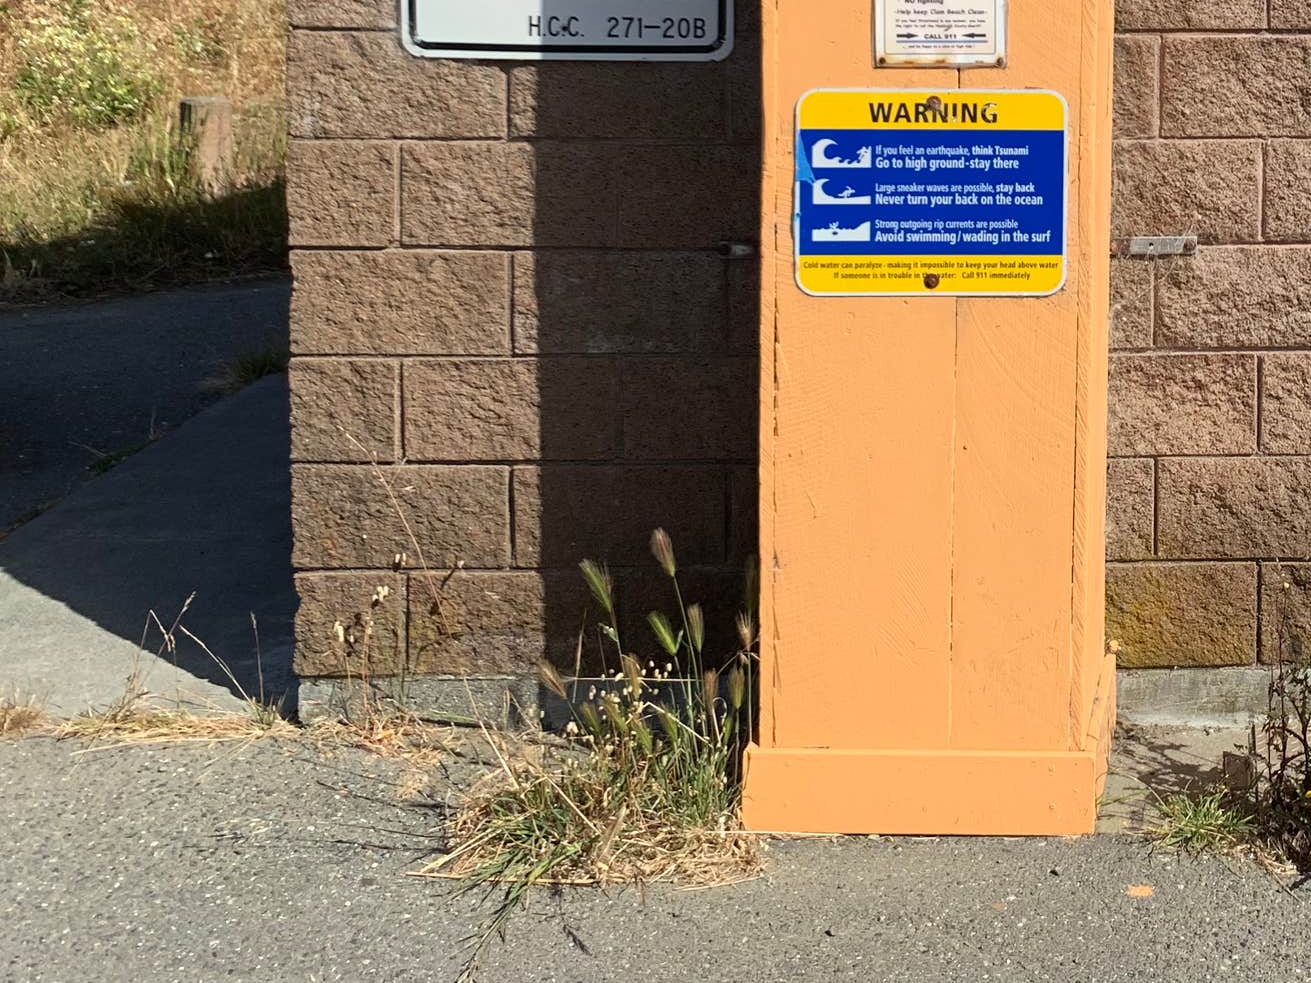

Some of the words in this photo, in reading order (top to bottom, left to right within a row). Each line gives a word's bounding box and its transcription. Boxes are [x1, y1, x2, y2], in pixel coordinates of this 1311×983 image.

[607, 16, 706, 39] 271-20B
[868, 102, 998, 123] WARNING
[875, 145, 882, 155] If
[882, 148, 898, 157] you
[899, 145, 913, 155] feel
[926, 145, 970, 157] earthquake,
[971, 145, 994, 155] think
[994, 145, 1029, 155] Tsunami
[875, 157, 890, 168] Go
[891, 157, 903, 168] to
[905, 156, 927, 171] high
[993, 157, 1019, 168] there
[875, 183, 896, 194] Large
[896, 182, 925, 192] sneaker
[996, 183, 1014, 195] stay
[1015, 182, 1035, 192] back
[875, 194, 905, 205] Never
[907, 194, 928, 205] turn
[930, 196, 954, 207] your
[955, 193, 978, 205] back
[981, 196, 994, 205] on
[996, 193, 1012, 205] the
[1014, 196, 1043, 205] ocean
[875, 219, 899, 231] Strong
[900, 219, 933, 231] outgoing
[933, 219, 945, 230] rip
[945, 220, 975, 228] currents
[989, 219, 1019, 230] possible
[875, 230, 904, 242] Avoid
[1001, 230, 1010, 242] in
[1013, 231, 1029, 242] the
[1032, 230, 1051, 242] surf
[803, 261, 819, 269] Cold
[855, 261, 882, 270] paralyze
[887, 261, 912, 270] making
[920, 261, 955, 270] impossible
[965, 261, 981, 270] keep
[989, 272, 1030, 281] immediately
